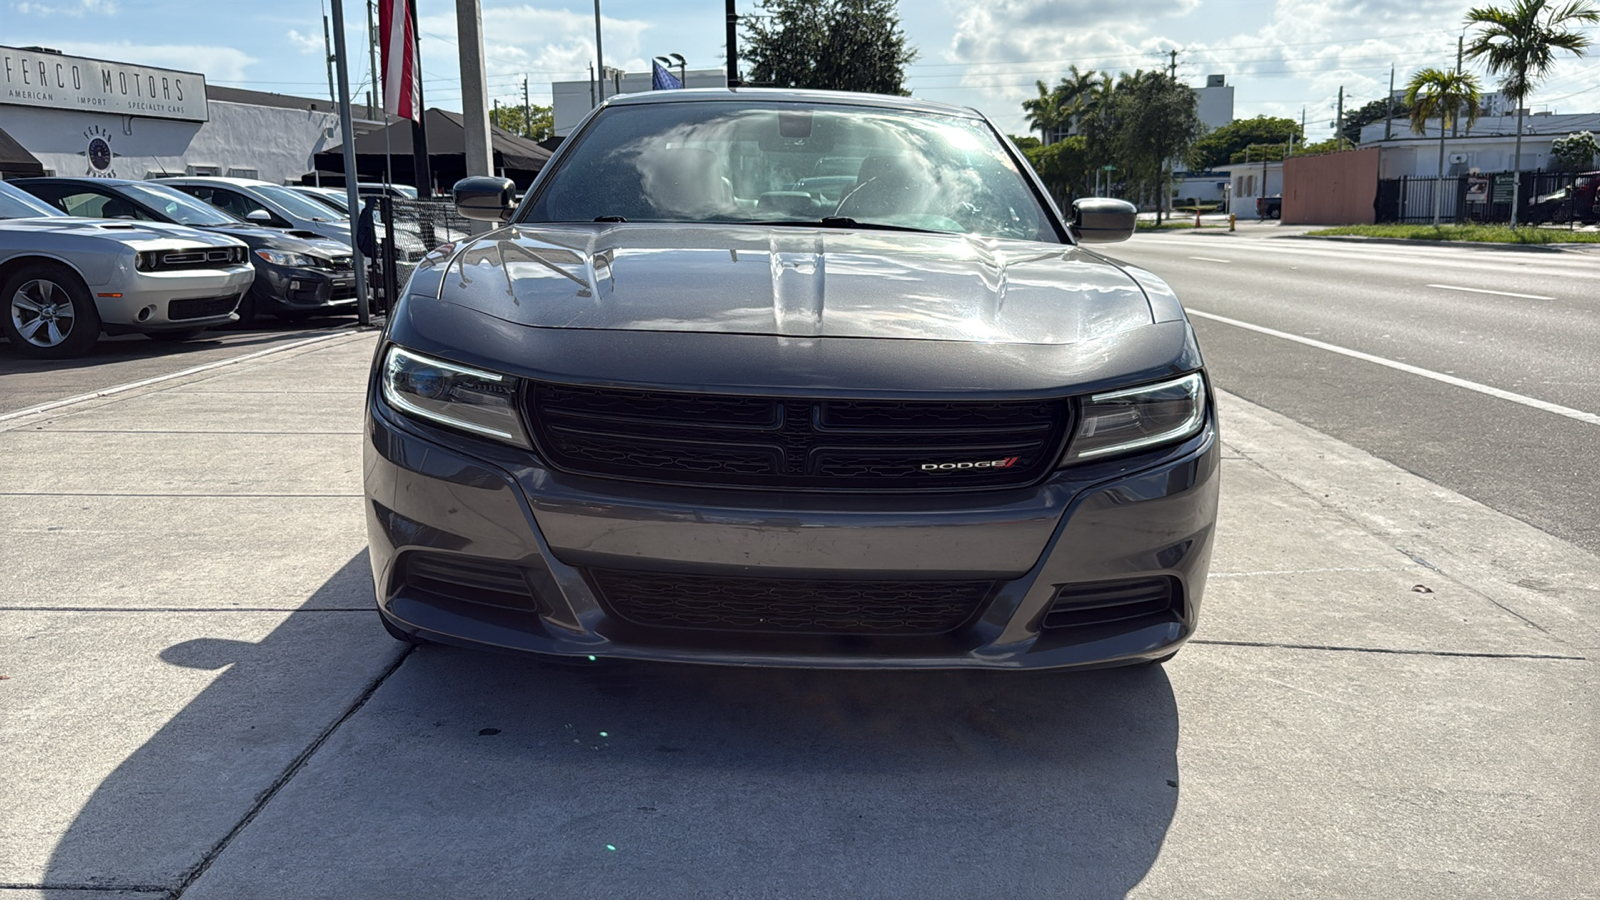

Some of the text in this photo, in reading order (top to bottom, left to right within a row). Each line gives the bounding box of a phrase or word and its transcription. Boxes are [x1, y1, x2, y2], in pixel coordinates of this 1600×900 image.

[5, 56, 183, 101] FERCO MOTORS
[8, 89, 185, 114] AMERICAN IMPORT SPECIALTY CARS
[921, 459, 1007, 470] DODGE
